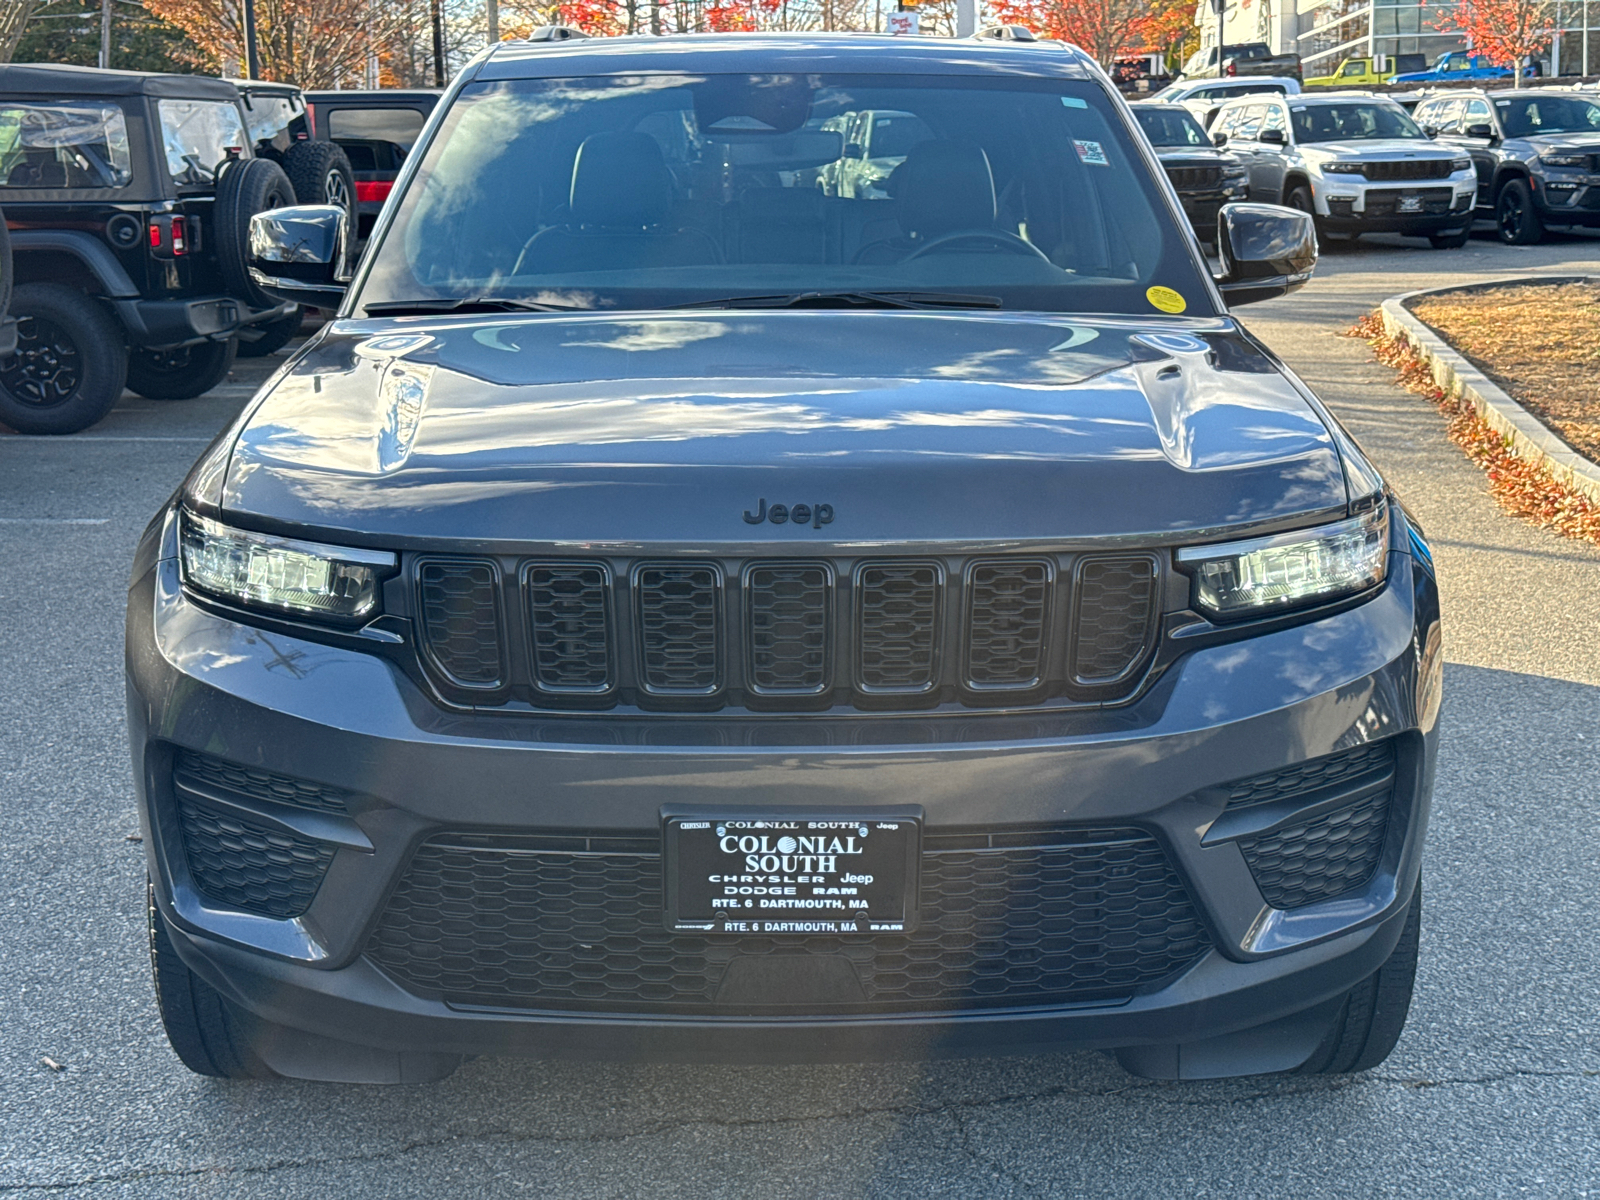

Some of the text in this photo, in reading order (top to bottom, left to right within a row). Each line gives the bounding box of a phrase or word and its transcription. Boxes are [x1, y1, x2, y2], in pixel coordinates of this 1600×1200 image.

[742, 498, 834, 529] Jeep
[725, 820, 799, 829] COLONIAL
[719, 835, 863, 854] COLONIAL
[746, 855, 837, 872] SOUTH
[709, 873, 873, 885] CHRYSLER Jeep
[724, 887, 796, 895] DODGE
[712, 899, 868, 910] RTE. 6 DARTMOUTH, MA
[725, 923, 857, 932] RTE. 6 DARTMOUTH, MA
